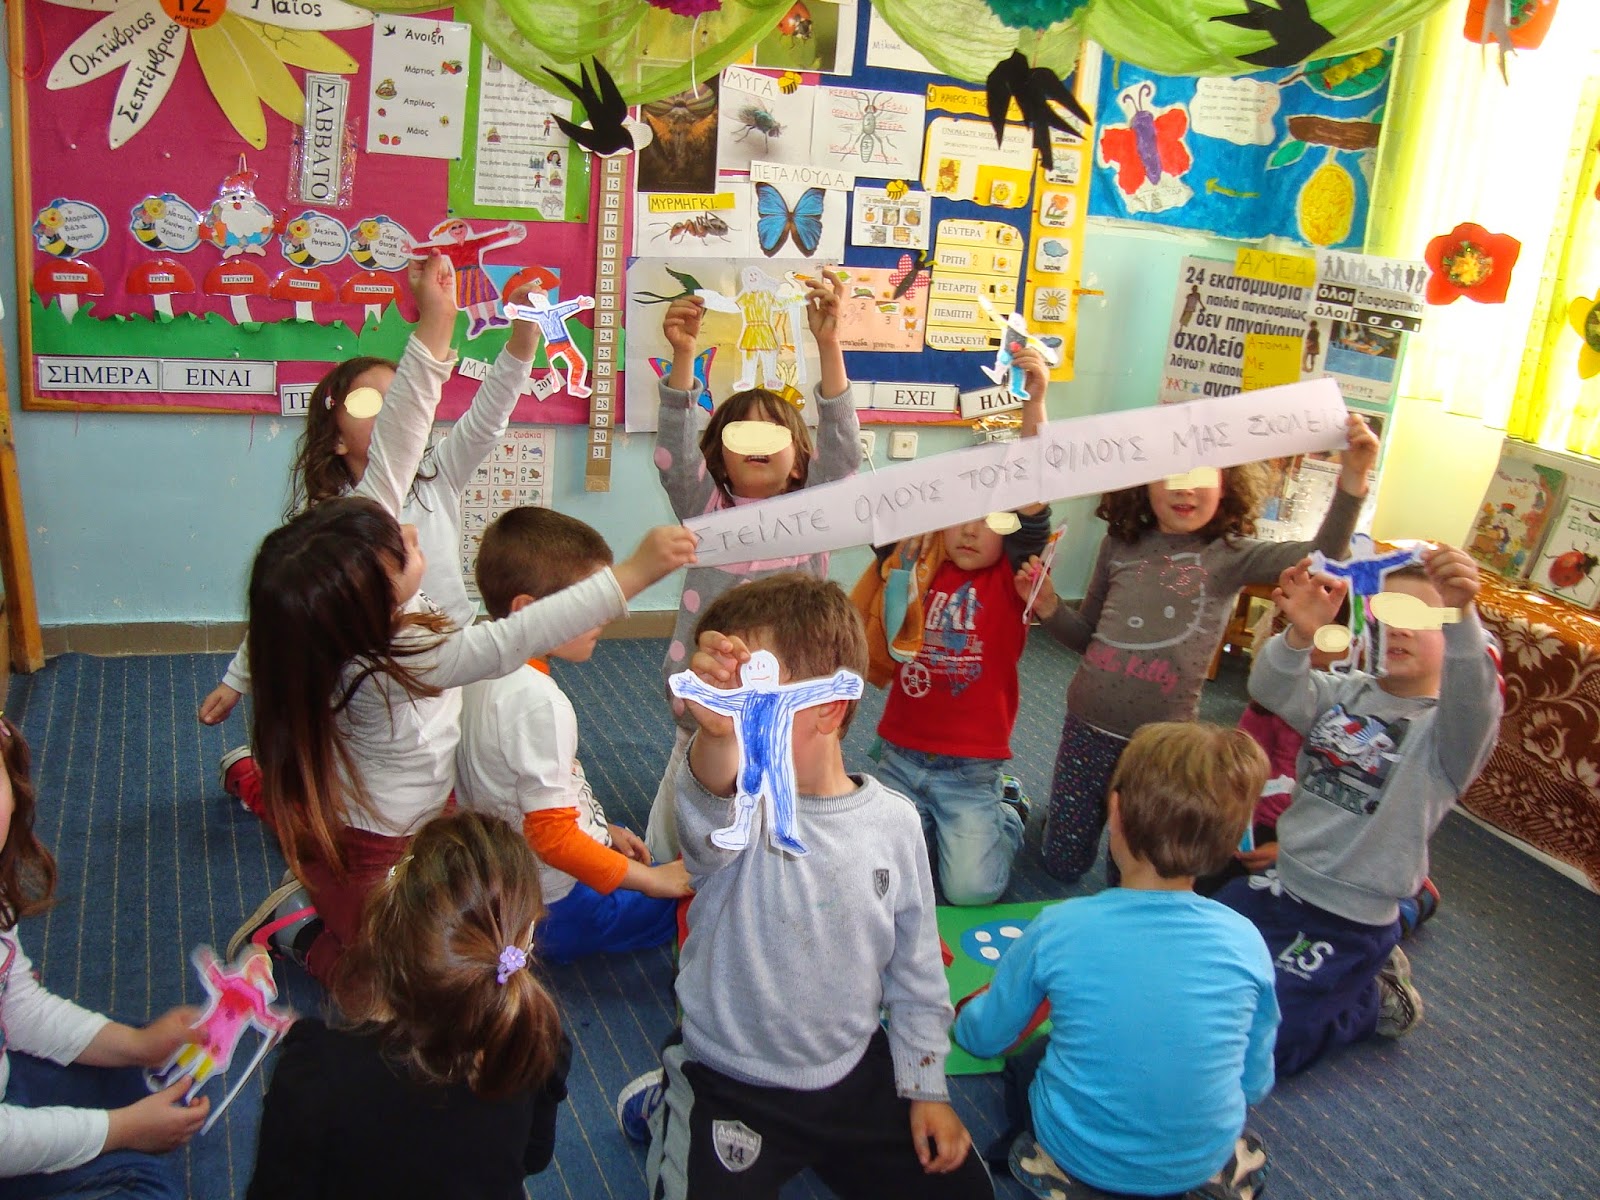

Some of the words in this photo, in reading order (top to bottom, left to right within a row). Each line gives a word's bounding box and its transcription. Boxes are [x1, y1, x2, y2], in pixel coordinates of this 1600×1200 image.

[405, 27, 444, 45] Άνοιξη
[69, 12, 156, 76] Οκτώβριος
[117, 23, 181, 124] Σεπτέμβριος
[404, 65, 435, 77] Μάρτιος
[726, 70, 774, 96] ΜΥΓΑ
[404, 98, 436, 109] Απρίλιος
[407, 126, 429, 137] Μάιος
[312, 84, 336, 200] ΣΑΒΒΑΤΟ
[610, 162, 619, 171] 14
[609, 180, 618, 189] 15
[608, 197, 618, 205] 16
[607, 213, 616, 222] 17
[606, 229, 616, 238] 18
[942, 226, 981, 238] ΔΕΥΤΕΡΑ
[605, 247, 614, 256] 19
[941, 254, 966, 265] ΤΡΙΤΗ
[603, 263, 613, 272] 20
[1238, 251, 1307, 280] ΑΜΕΑ
[1185, 266, 1205, 285] 24
[290, 281, 318, 289] ΠΕΜΠΤΗ
[355, 286, 393, 294] ΠΑΡΑΣΚΕΥΗ
[602, 281, 612, 290] 21
[937, 282, 977, 294] ΤΕΤΑΡΤΗ
[1318, 285, 1355, 305] όλοι
[602, 298, 612, 307] 22
[1206, 293, 1240, 310] παιδιά
[1242, 299, 1307, 322] παγκοσμίως
[934, 308, 973, 319] ΠΕΜΠΤΗ
[1314, 304, 1349, 320] όλοι
[602, 315, 612, 324] 23
[1196, 308, 1221, 329] δεν
[601, 332, 611, 341] 24
[930, 334, 984, 346] ΠΑΡΑΣΚΕΥΗ
[1174, 331, 1244, 359] σχολείο
[600, 349, 610, 358] 25
[1169, 353, 1199, 370] λόγω
[462, 361, 487, 377] ΜΑ
[599, 365, 609, 374] 26
[47, 365, 153, 386] ΣΗΜΕΡΑ
[185, 368, 252, 387] ΕΙΝΑΙ
[536, 377, 552, 392] 201
[598, 383, 608, 392] 27
[284, 392, 310, 410] ΤΕ
[597, 399, 607, 408] 28
[894, 389, 936, 407] ΕΧΕΙ
[597, 417, 607, 426] 29
[513, 430, 542, 439] ζωάκια
[595, 432, 606, 441] 30
[594, 448, 604, 457] 31
[957, 456, 1031, 492] ΤΟΥΣ
[1044, 435, 1150, 473] ΦΙΛΟΥΣ
[1172, 421, 1237, 457] ΜΑΣ
[726, 1144, 745, 1165] 14
